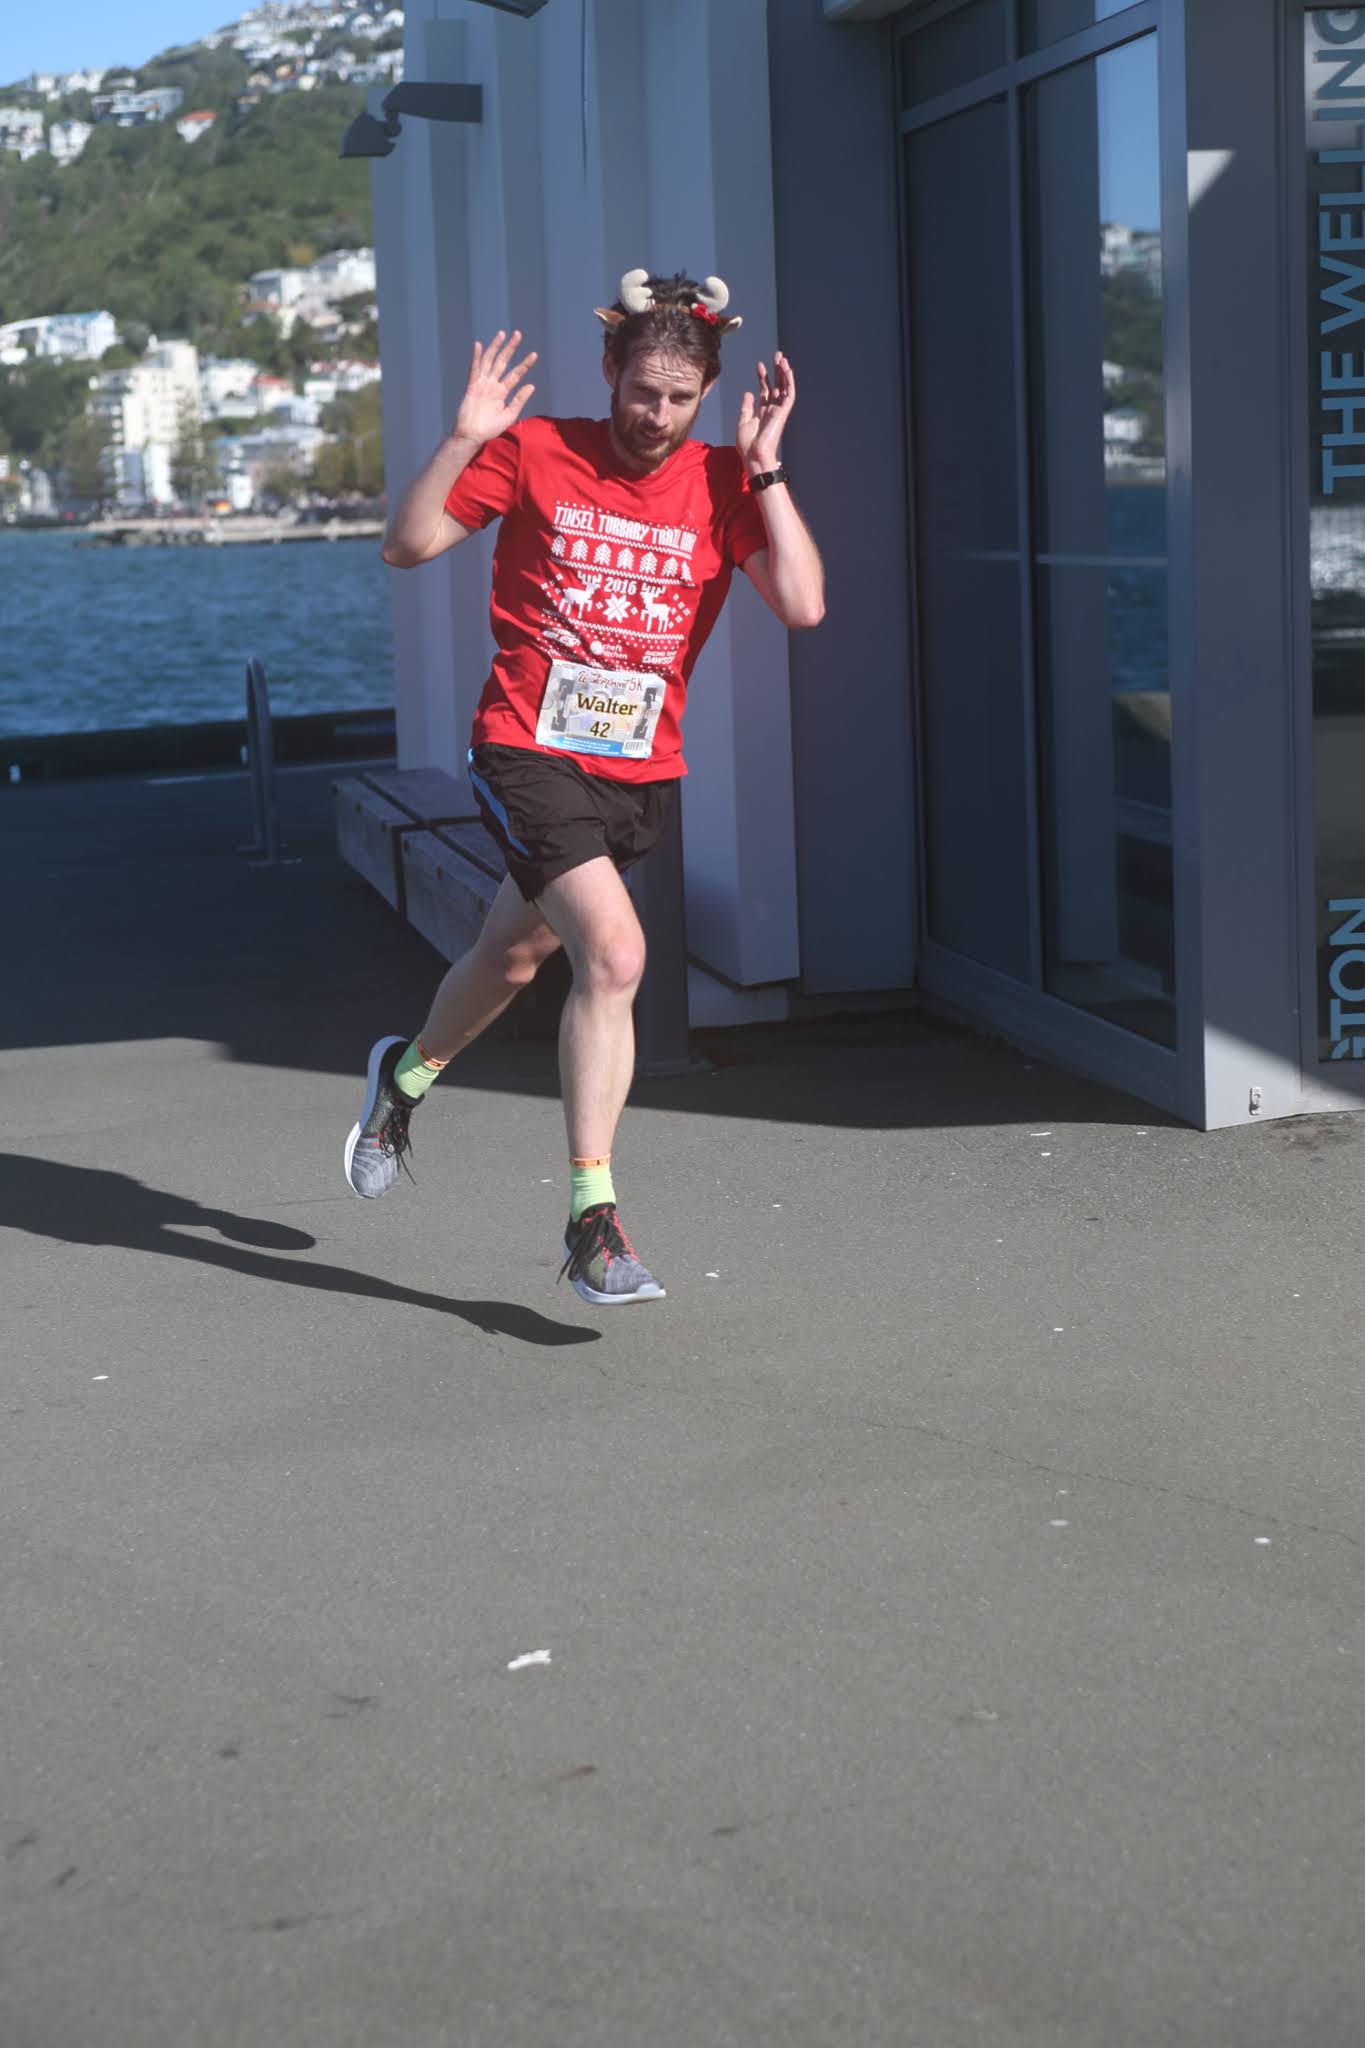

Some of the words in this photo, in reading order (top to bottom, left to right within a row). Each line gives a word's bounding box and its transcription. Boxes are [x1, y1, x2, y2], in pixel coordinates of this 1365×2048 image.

[1320, 350, 1365, 496] THE
[554, 506, 594, 531] TINSEL
[651, 527, 682, 550] TRAIL
[603, 576, 637, 596] 2016
[628, 677, 644, 692] 5K
[576, 692, 637, 716] Walter
[590, 721, 611, 738] 42
